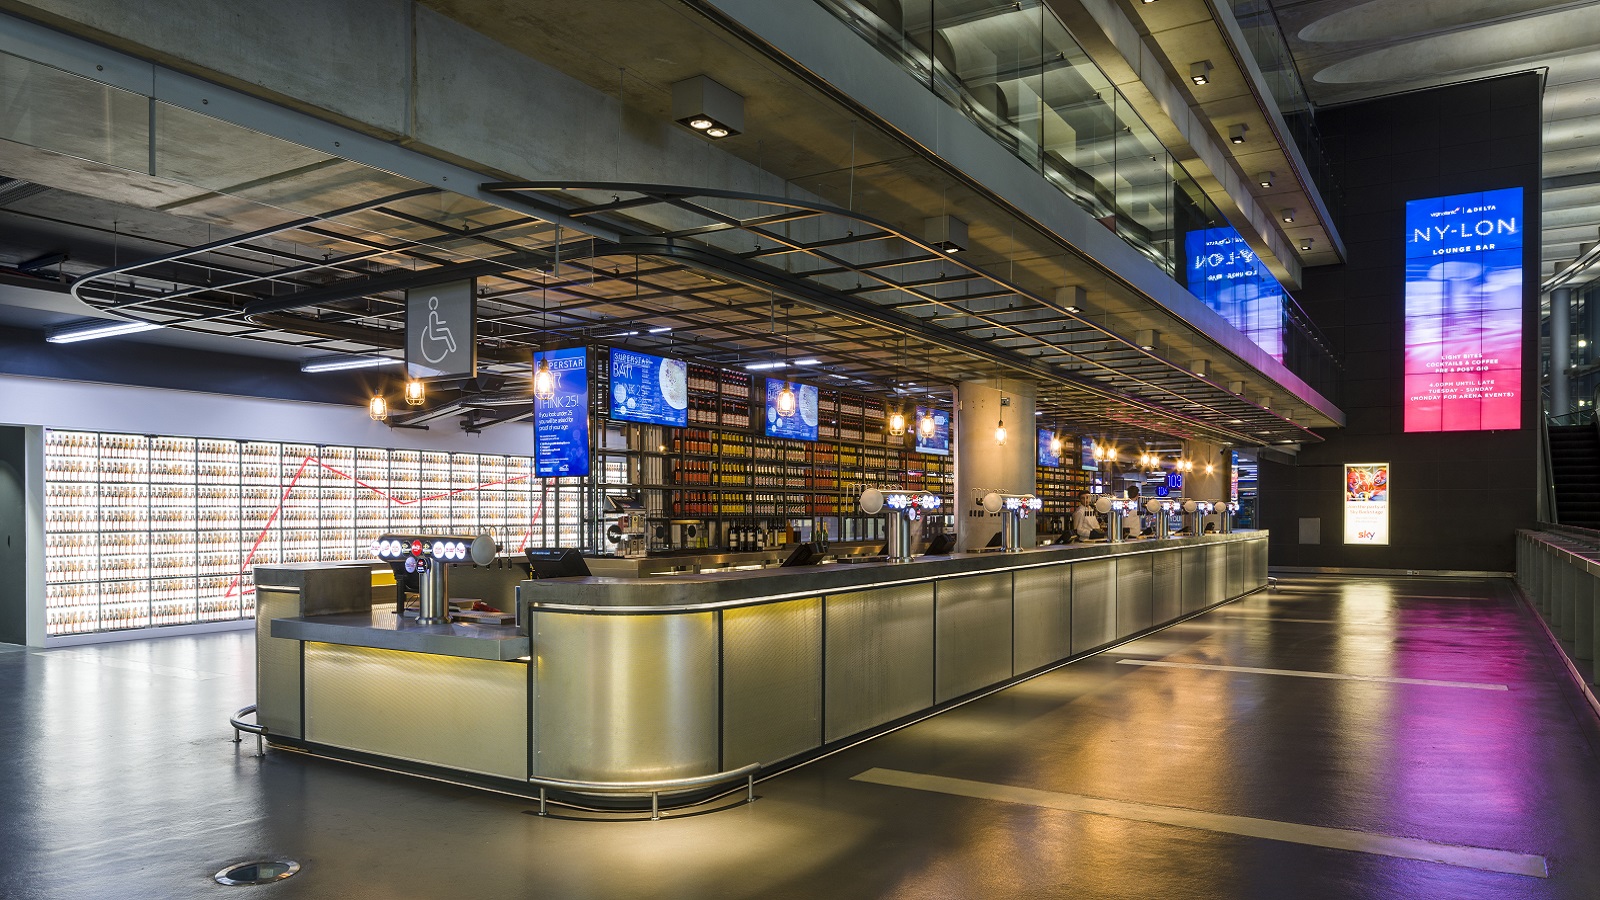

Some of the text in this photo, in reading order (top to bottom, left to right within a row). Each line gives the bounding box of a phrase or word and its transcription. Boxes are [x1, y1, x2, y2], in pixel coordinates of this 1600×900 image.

[1473, 205, 1496, 213] DELTA
[1414, 217, 1515, 243] NY-LON
[1432, 243, 1496, 256] LOUNGE BAR
[538, 359, 583, 370] PERSTAR
[614, 352, 650, 365] SUPERSTAR
[540, 394, 579, 409] THINK 25!
[1358, 530, 1376, 540] sky
